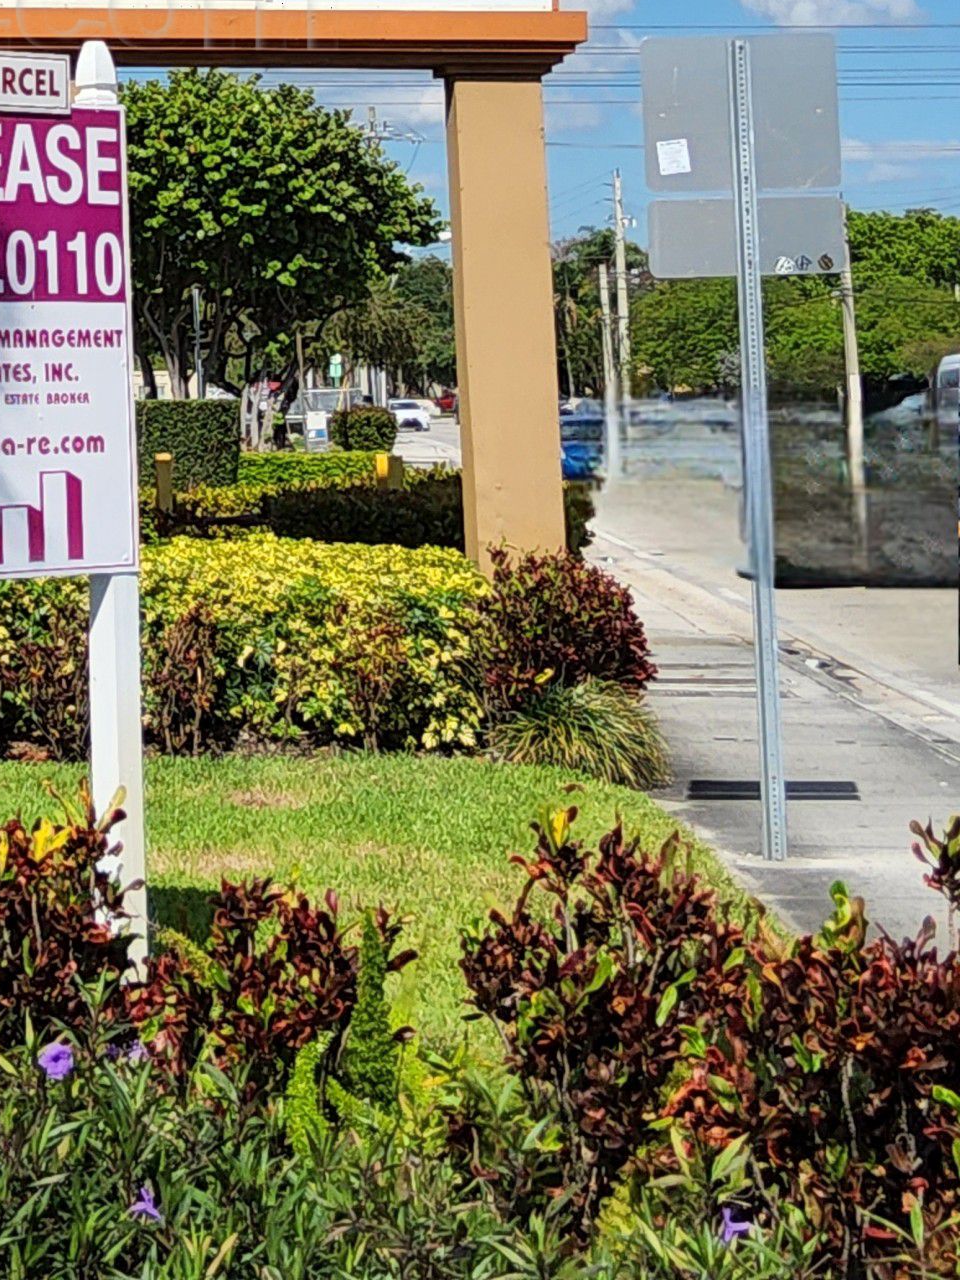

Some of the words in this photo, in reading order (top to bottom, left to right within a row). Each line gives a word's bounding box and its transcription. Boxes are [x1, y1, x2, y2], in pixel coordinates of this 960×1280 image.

[45, 363, 80, 383] INC.
[4, 393, 40, 406] ESTATE
[46, 392, 90, 405] BROKER
